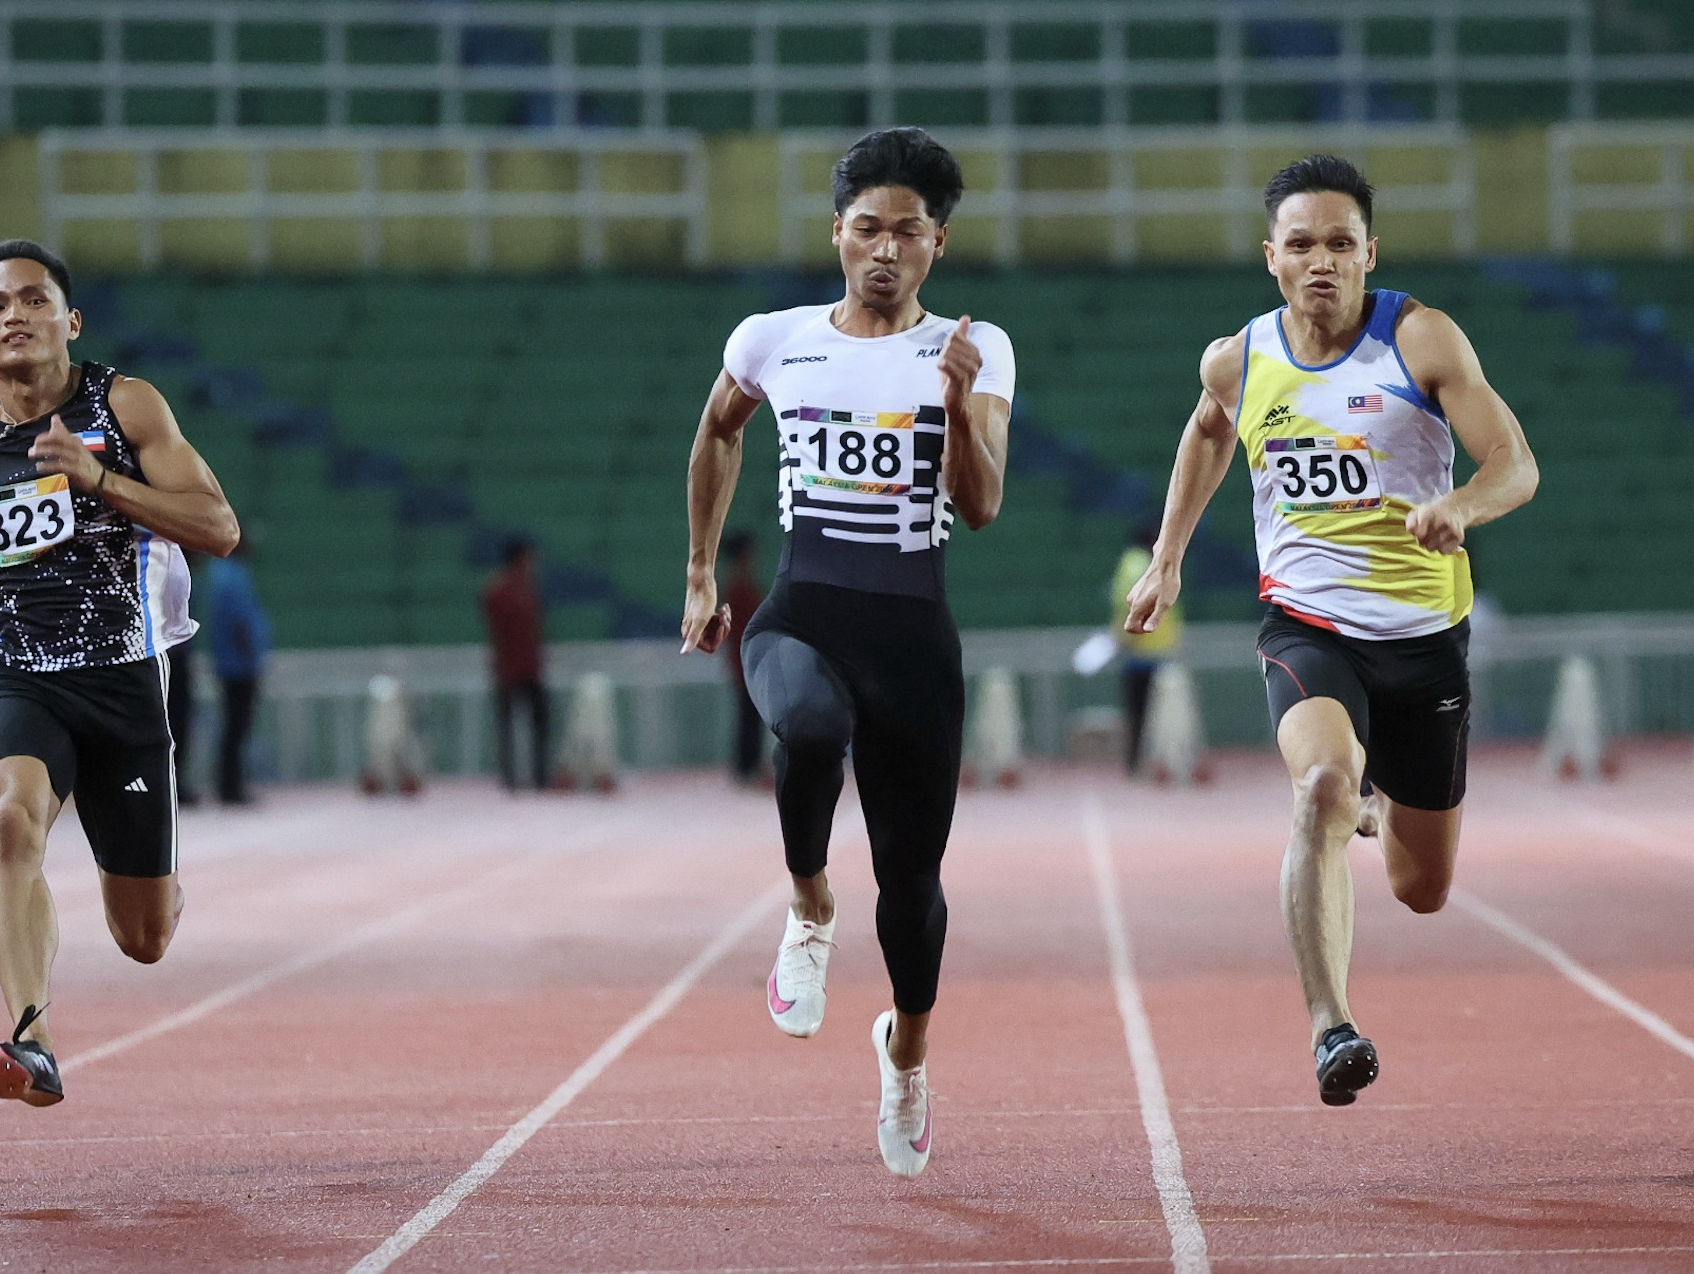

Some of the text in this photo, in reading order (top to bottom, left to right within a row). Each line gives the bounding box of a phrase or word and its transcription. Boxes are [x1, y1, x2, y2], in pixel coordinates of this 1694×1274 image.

[1258, 415, 1296, 431] AGT
[808, 427, 901, 479] 188
[1276, 454, 1368, 498] 350
